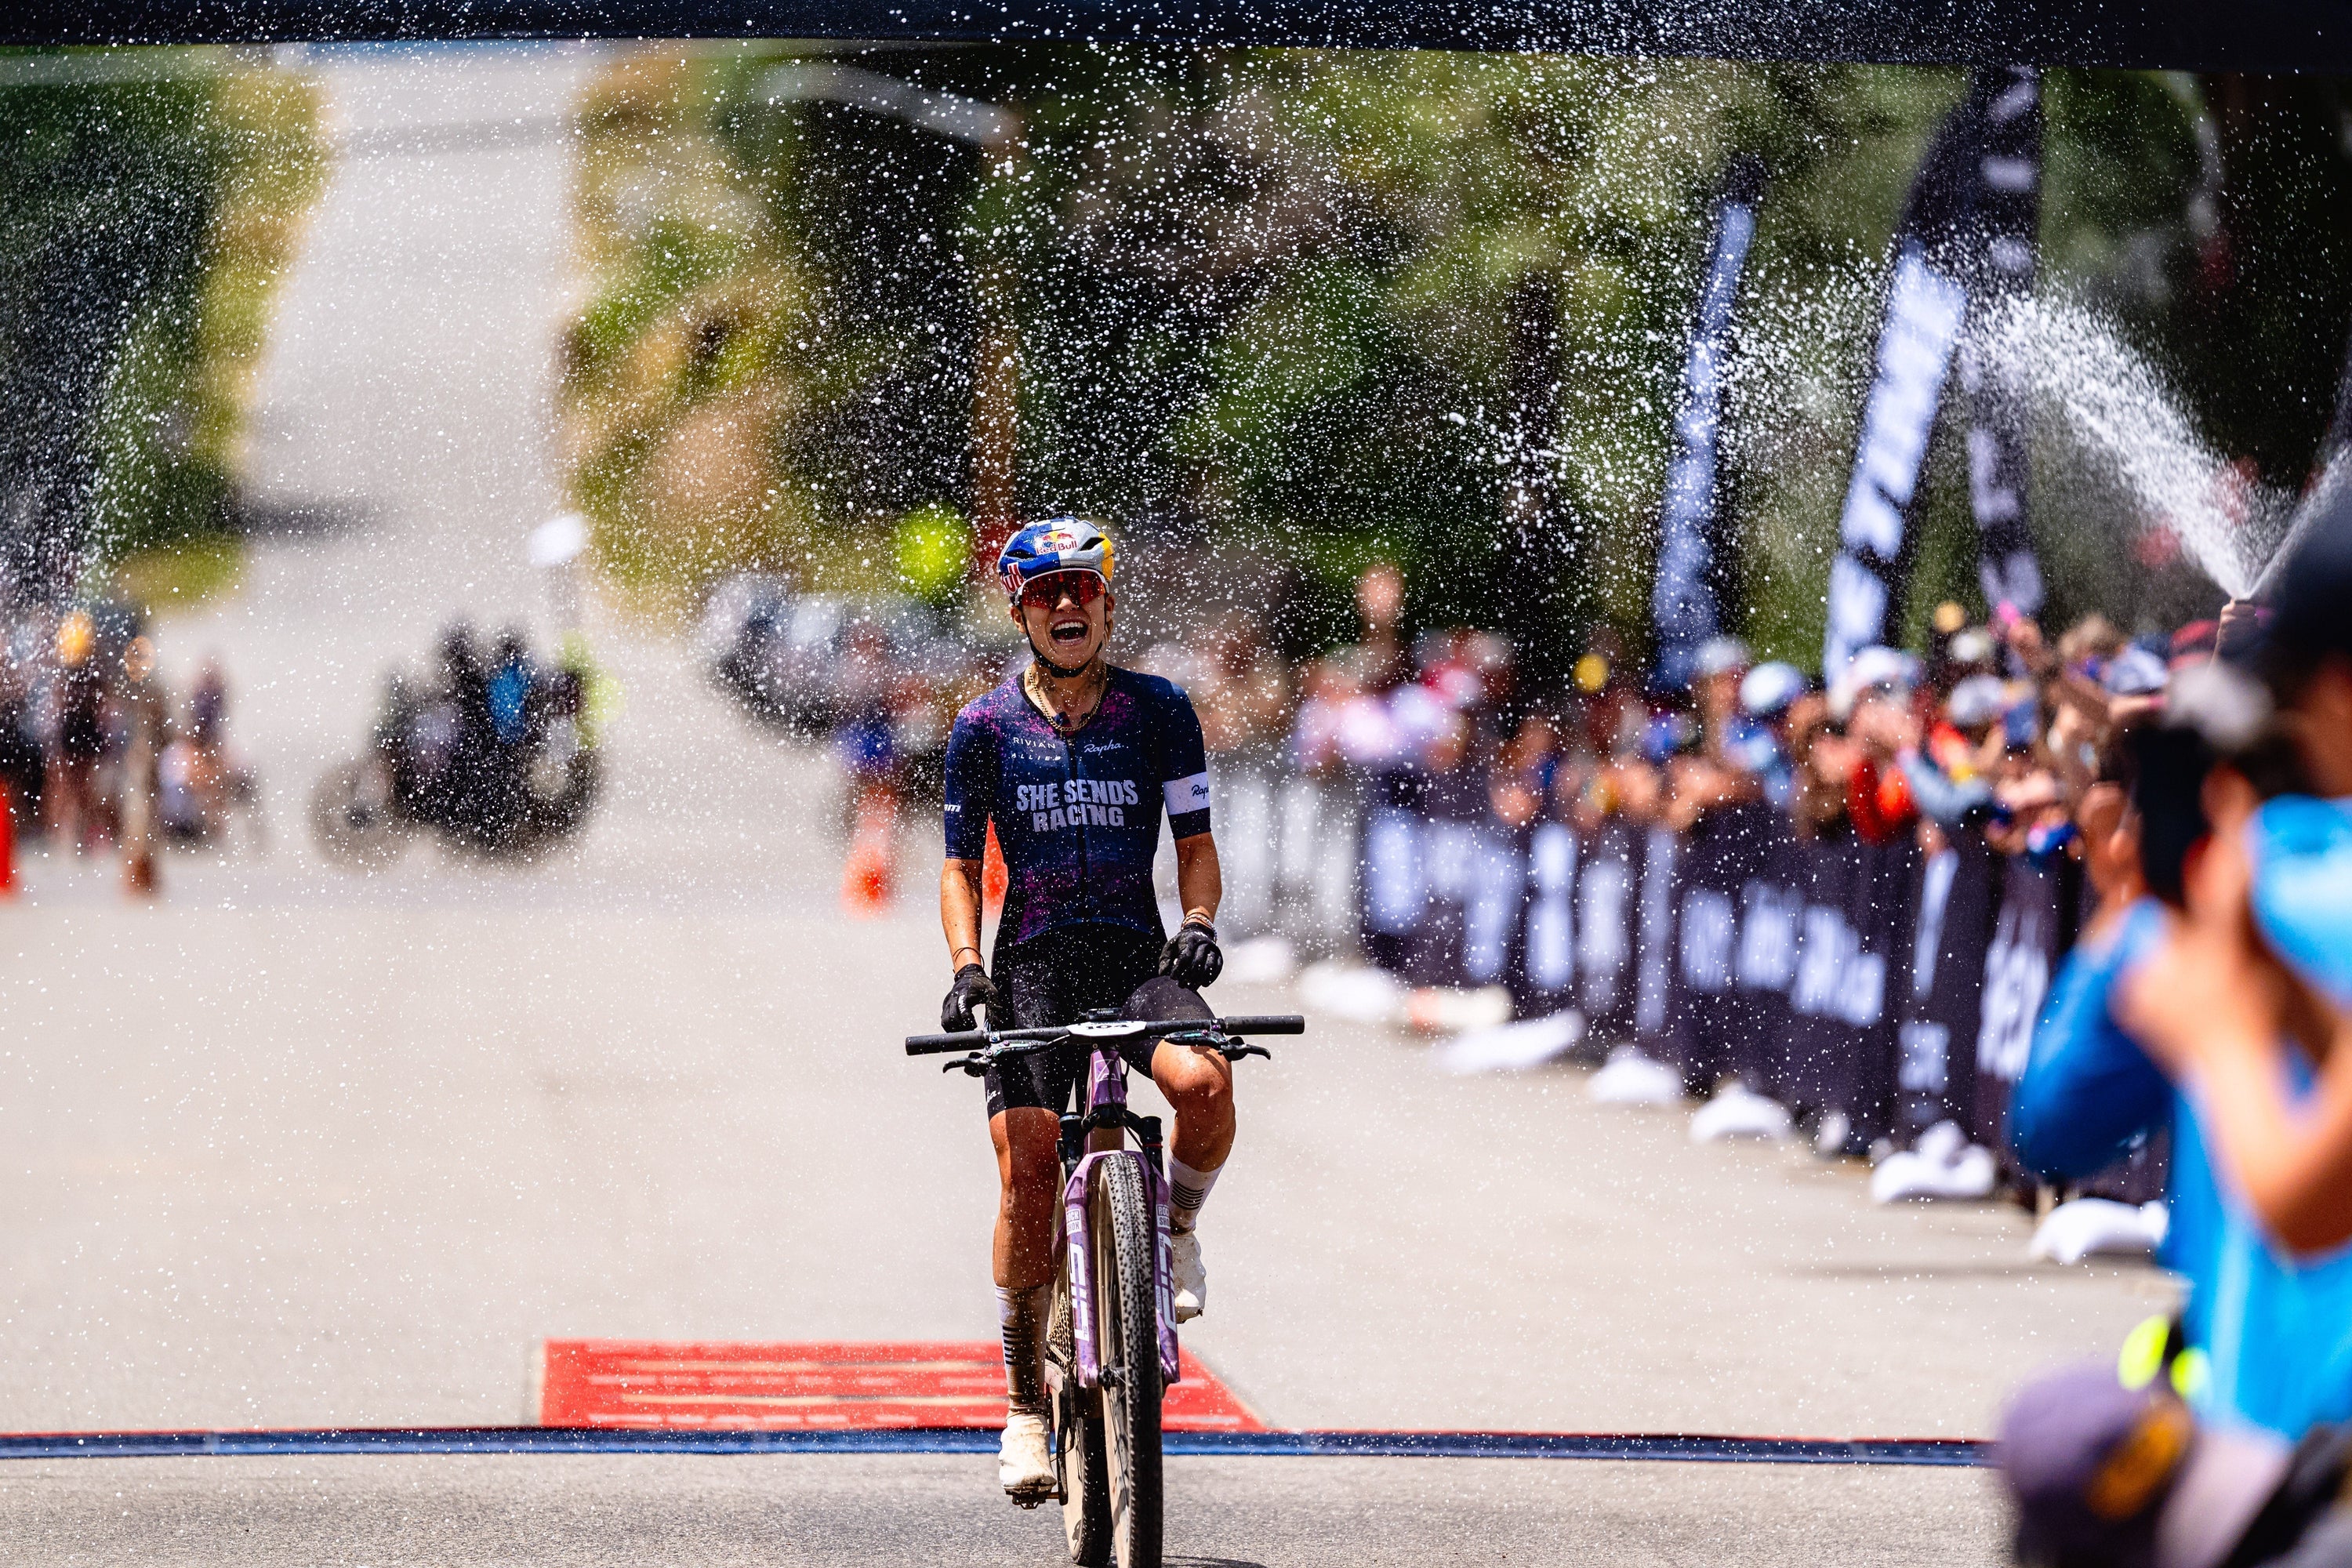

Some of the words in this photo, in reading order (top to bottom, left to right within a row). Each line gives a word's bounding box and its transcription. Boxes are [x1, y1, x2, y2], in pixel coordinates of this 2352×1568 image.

[1036, 544, 1057, 555] Red
[1058, 541, 1078, 551] Bull
[1013, 737, 1056, 749] RIVIAN
[1016, 783, 1060, 811] SHE
[1063, 779, 1138, 805] SENDS
[1033, 804, 1125, 833] RACING
